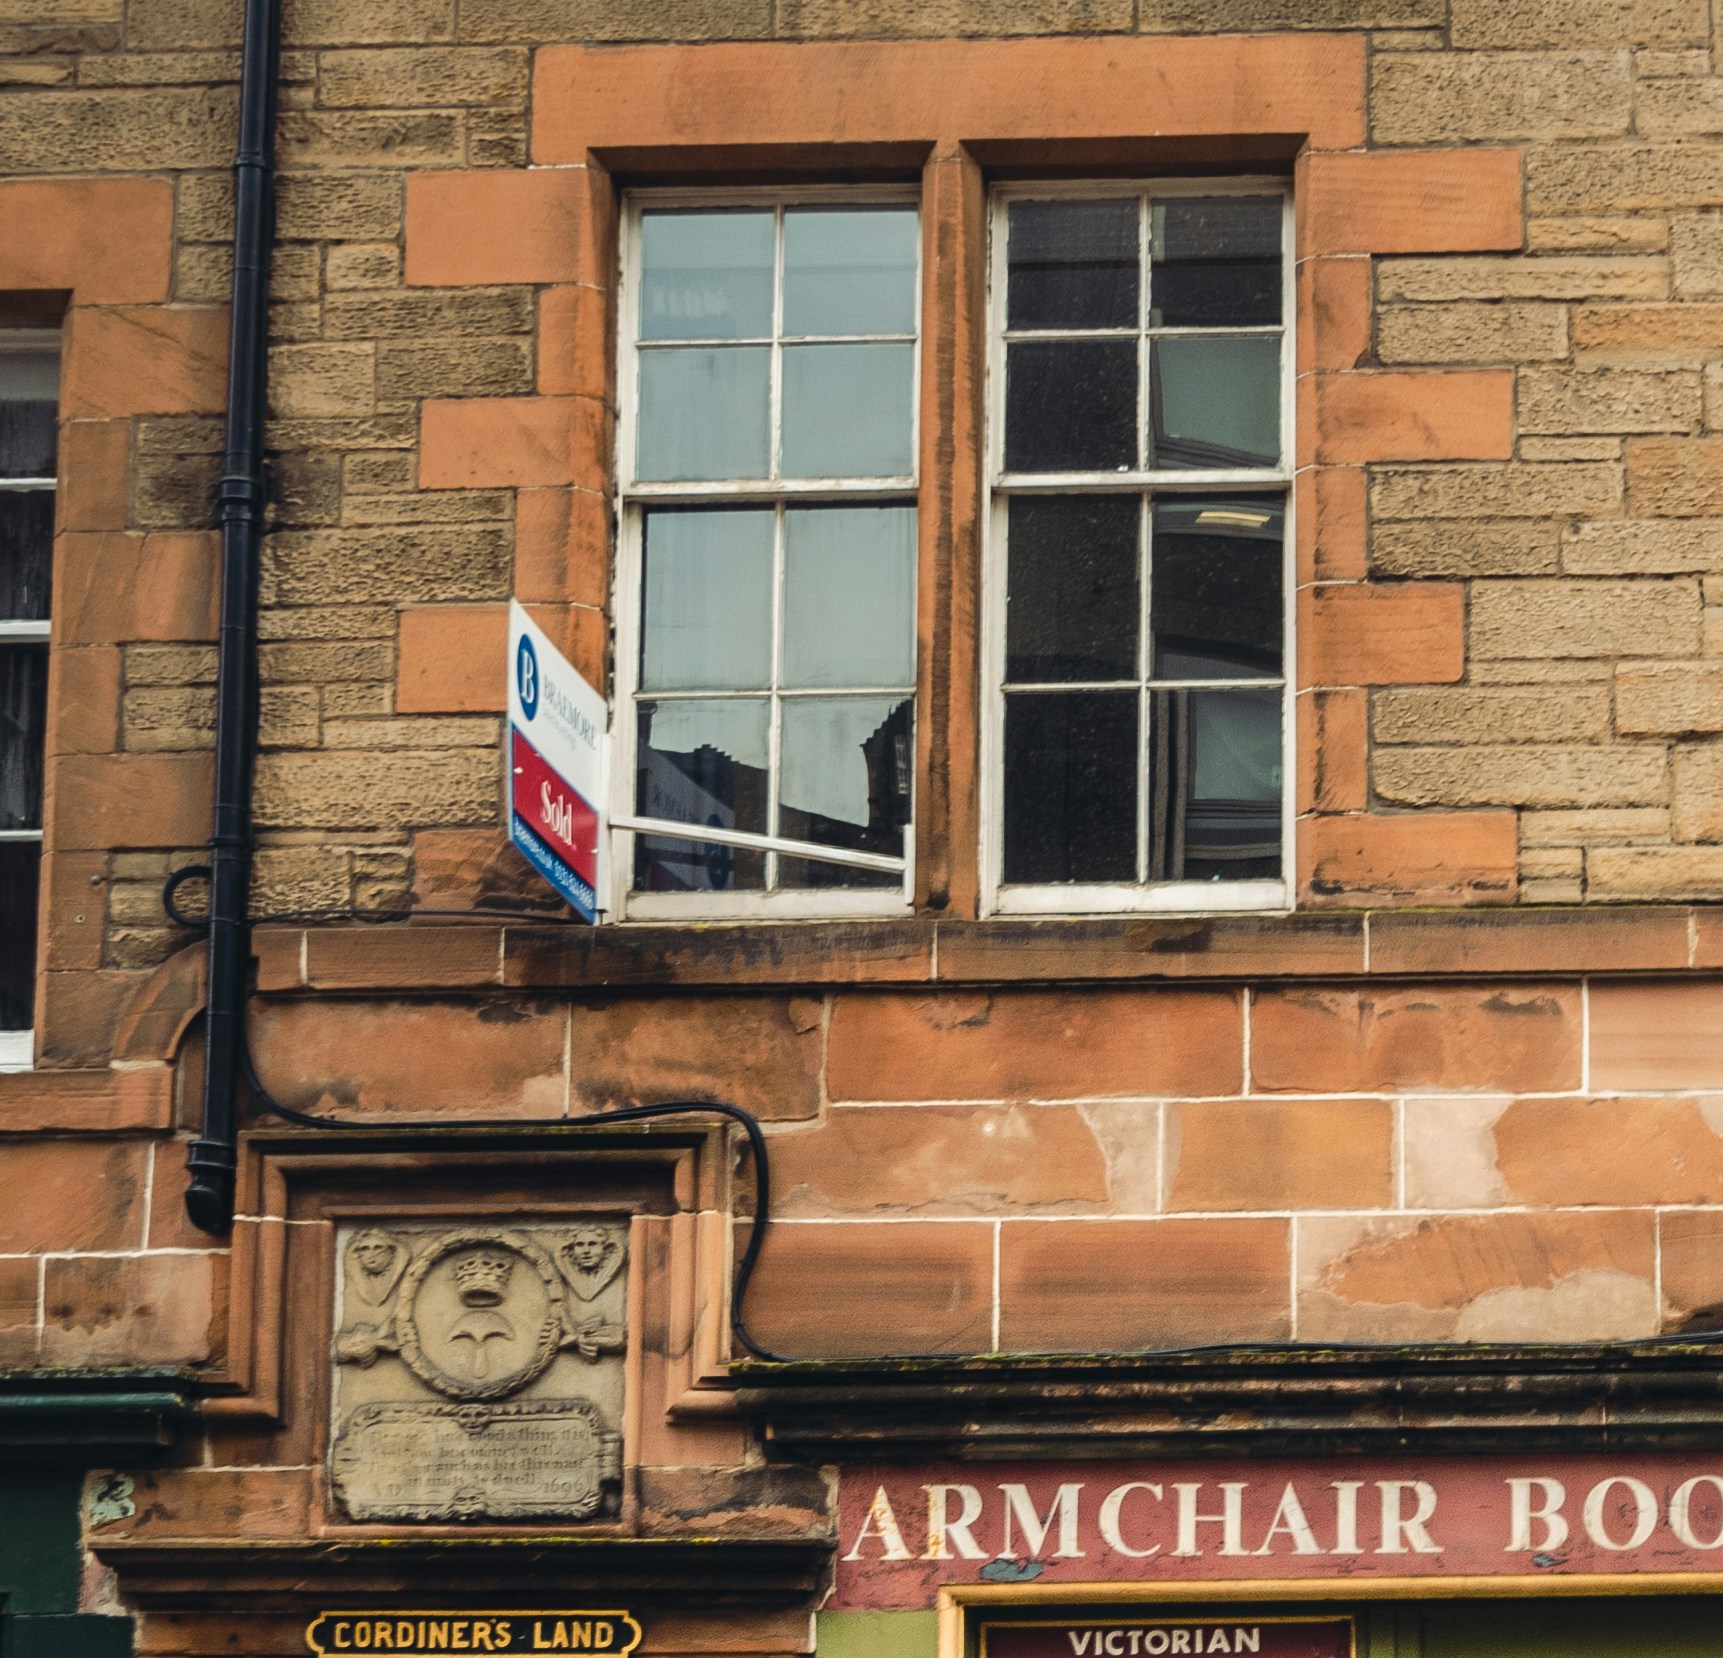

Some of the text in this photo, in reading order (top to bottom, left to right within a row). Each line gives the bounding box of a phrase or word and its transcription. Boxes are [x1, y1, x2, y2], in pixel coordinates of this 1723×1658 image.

[520, 648, 535, 704] B
[541, 780, 574, 846] Sold
[841, 1477, 1446, 1564] ARMCHAIR
[333, 1618, 614, 1650] CORDINER'S LAND
[1068, 1627, 1261, 1656] VICTORIAN
